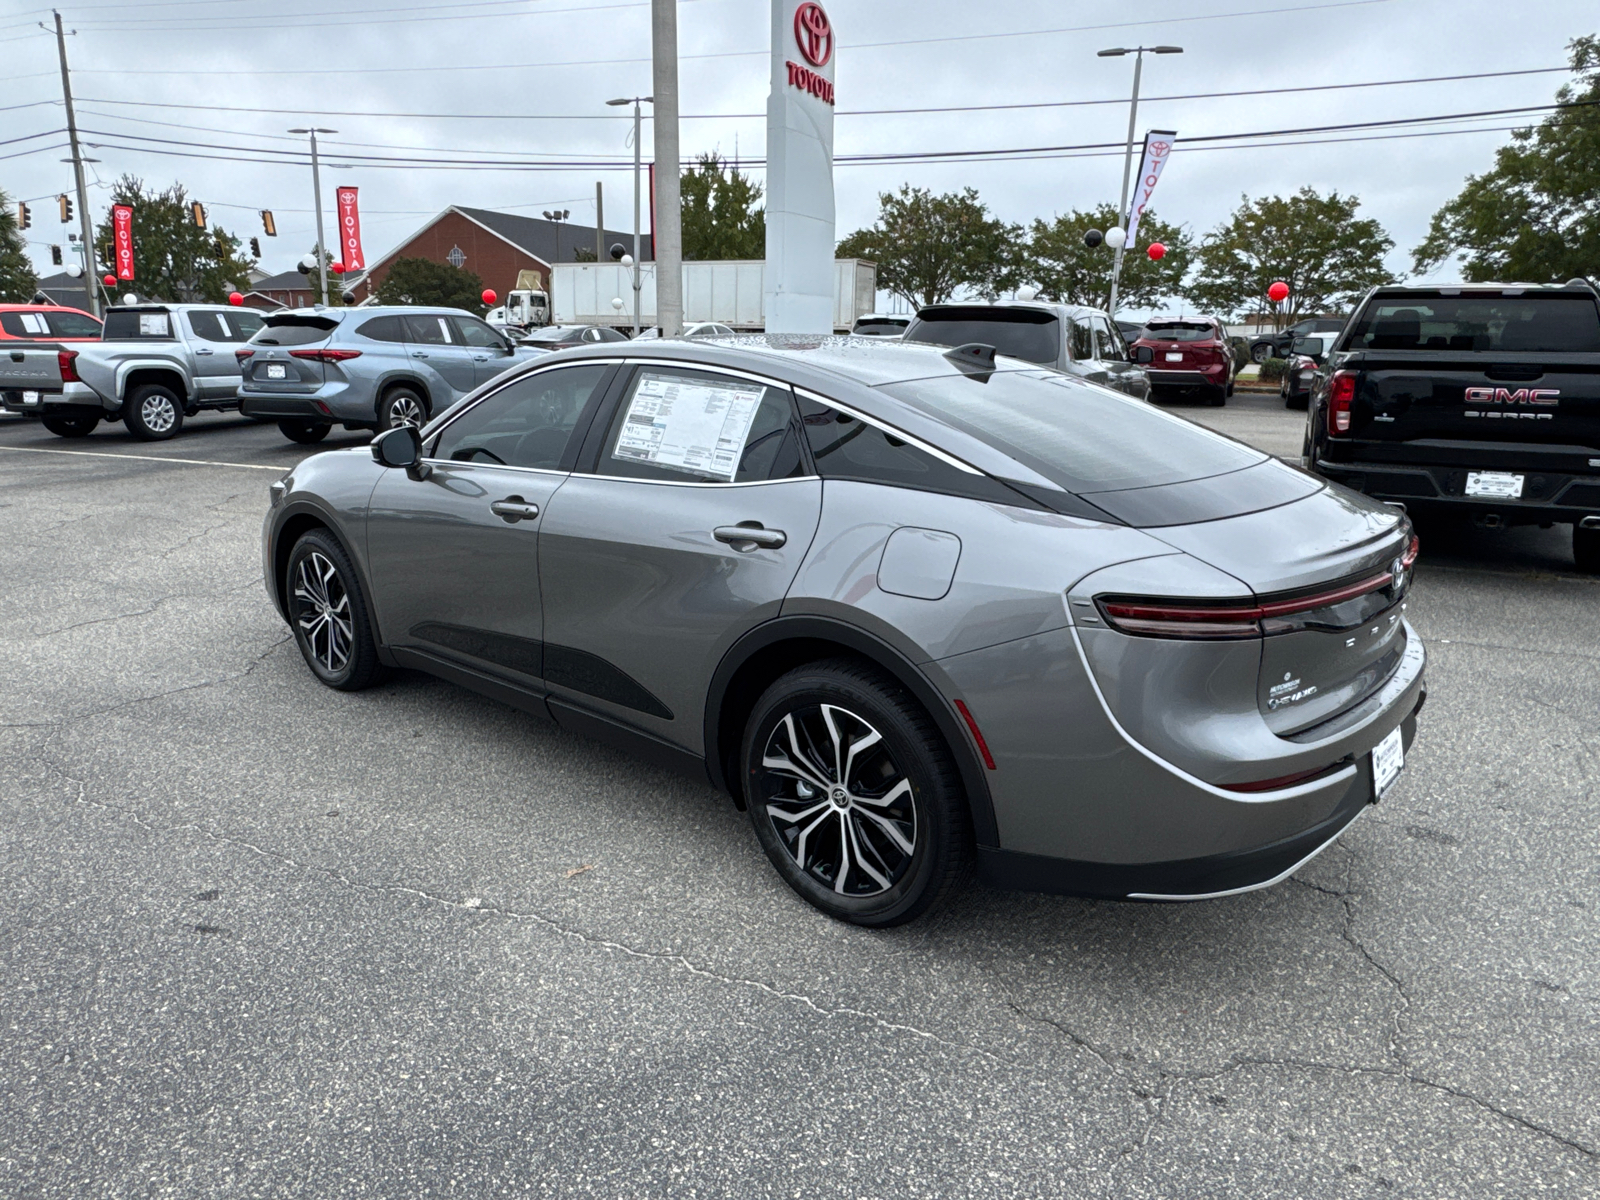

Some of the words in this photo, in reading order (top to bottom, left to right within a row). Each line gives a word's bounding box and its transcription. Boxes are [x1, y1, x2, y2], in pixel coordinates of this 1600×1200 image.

[786, 60, 835, 106] TOYOTA
[119, 221, 131, 277] TOYOTA
[345, 205, 360, 269] TOYOTA
[1464, 411, 1553, 420] SIERRA
[1465, 387, 1560, 405] GMC
